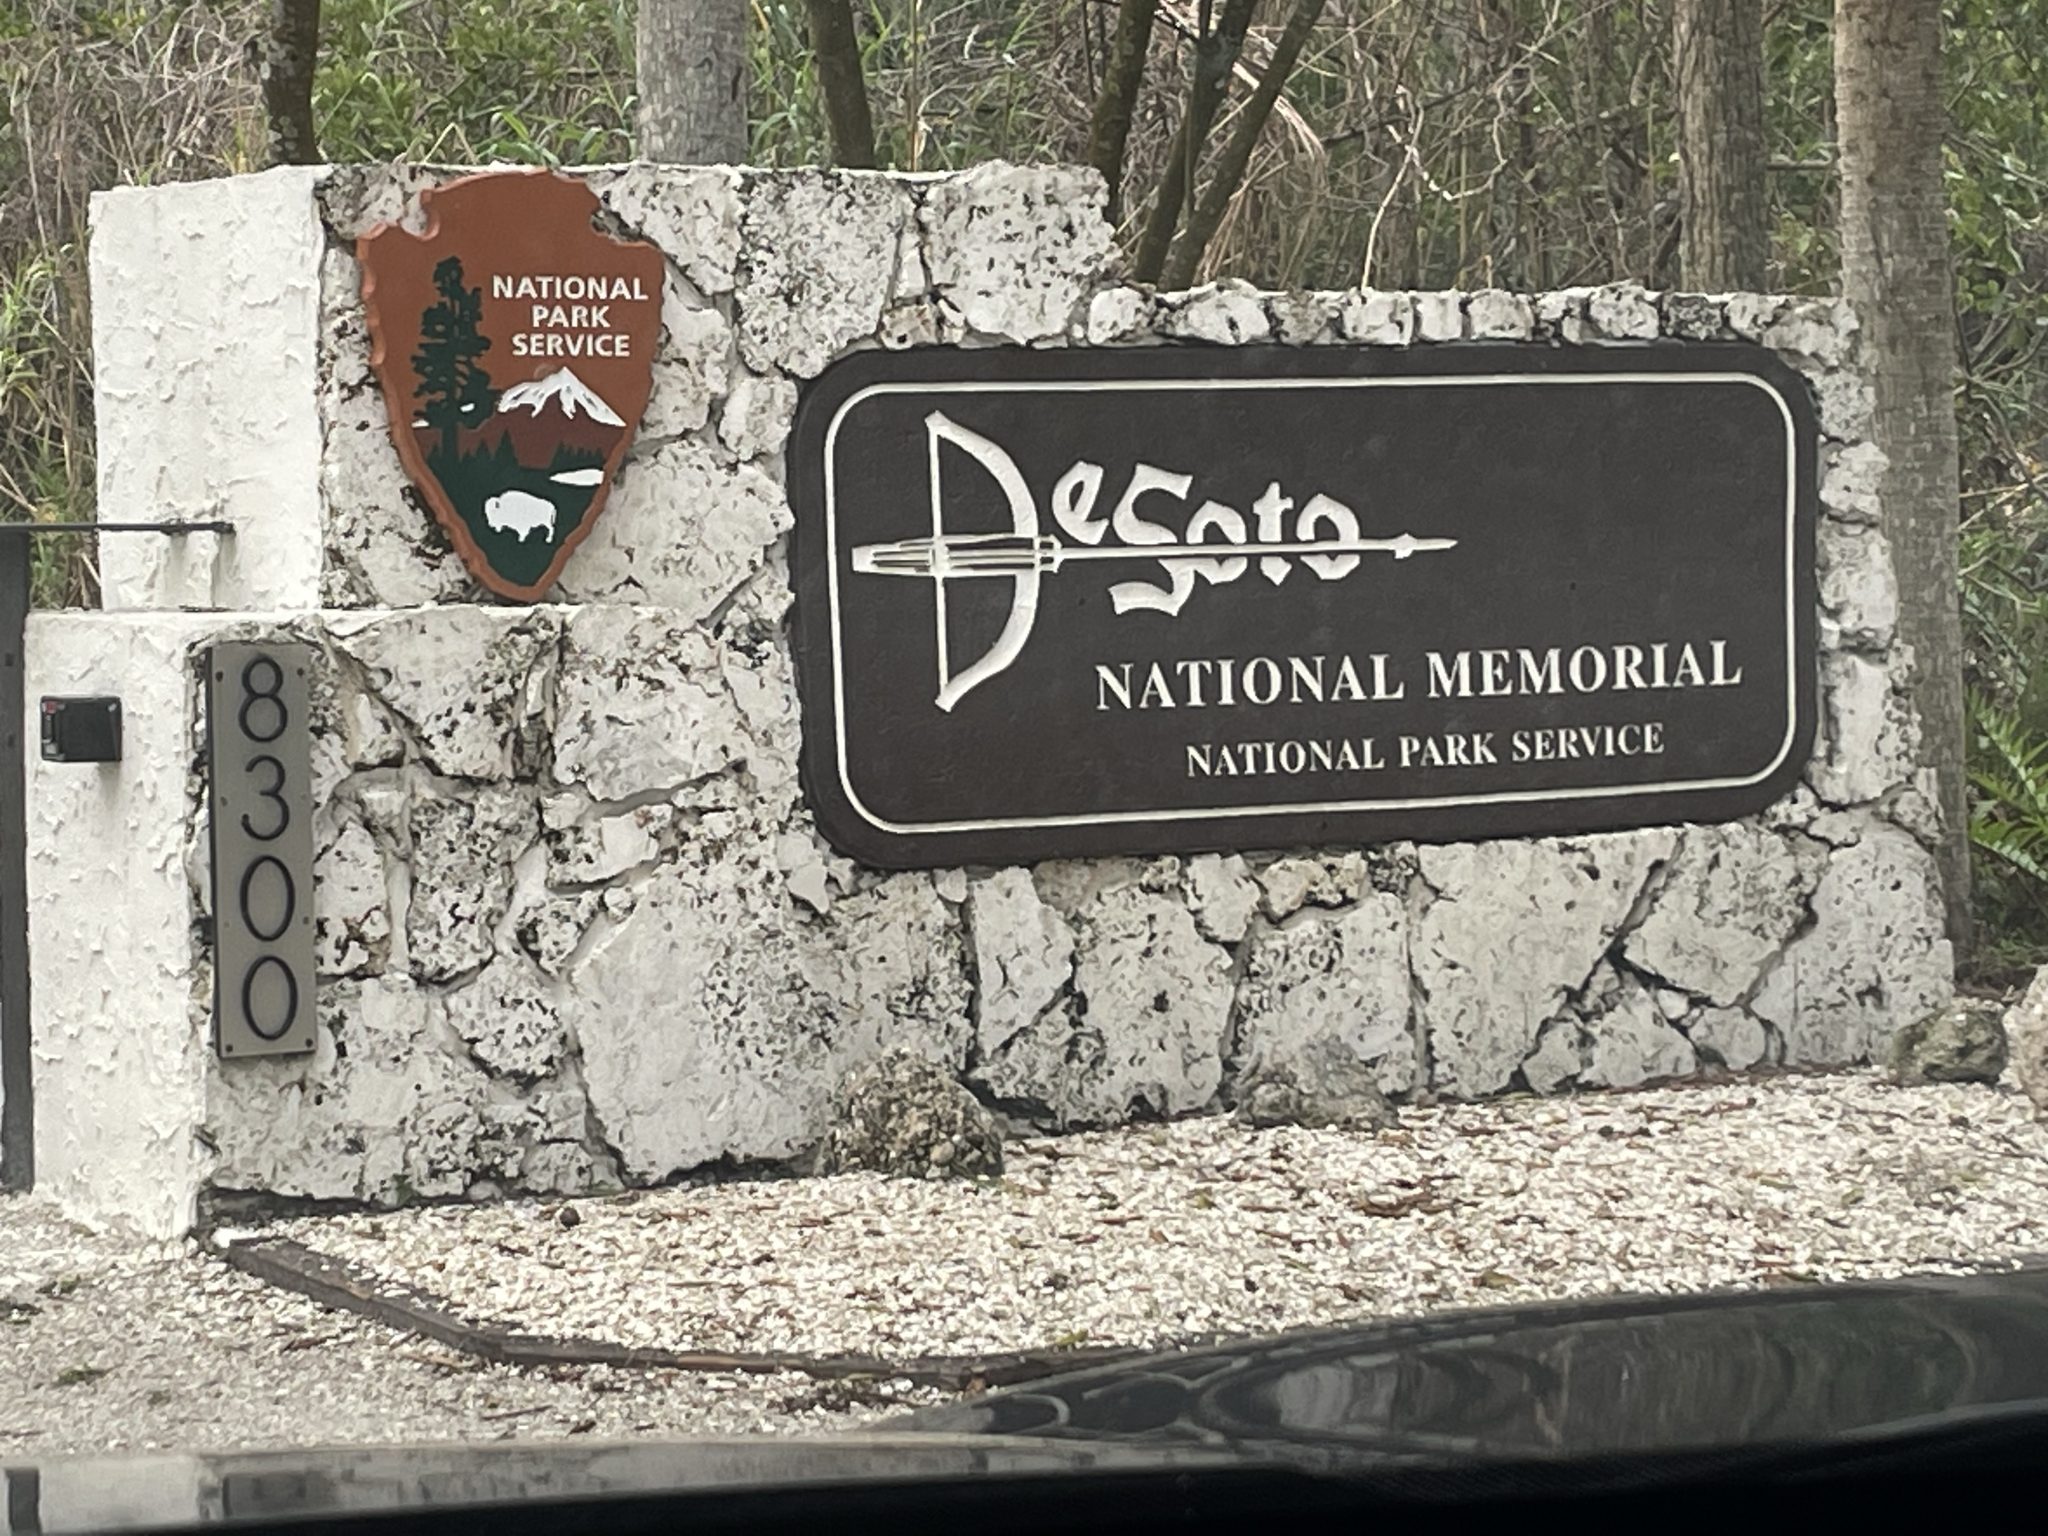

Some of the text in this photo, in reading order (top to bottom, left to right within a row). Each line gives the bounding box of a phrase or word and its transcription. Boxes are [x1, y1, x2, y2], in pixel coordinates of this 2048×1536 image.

[491, 274, 649, 301] NATIONAL
[531, 304, 611, 329] PARK
[511, 332, 631, 358] SERVICE
[1096, 639, 1743, 711] NATIONAL MEMORIAL
[1185, 721, 1666, 778] NATIONAL PARK SERVICE
[238, 655, 299, 1041] 8300
